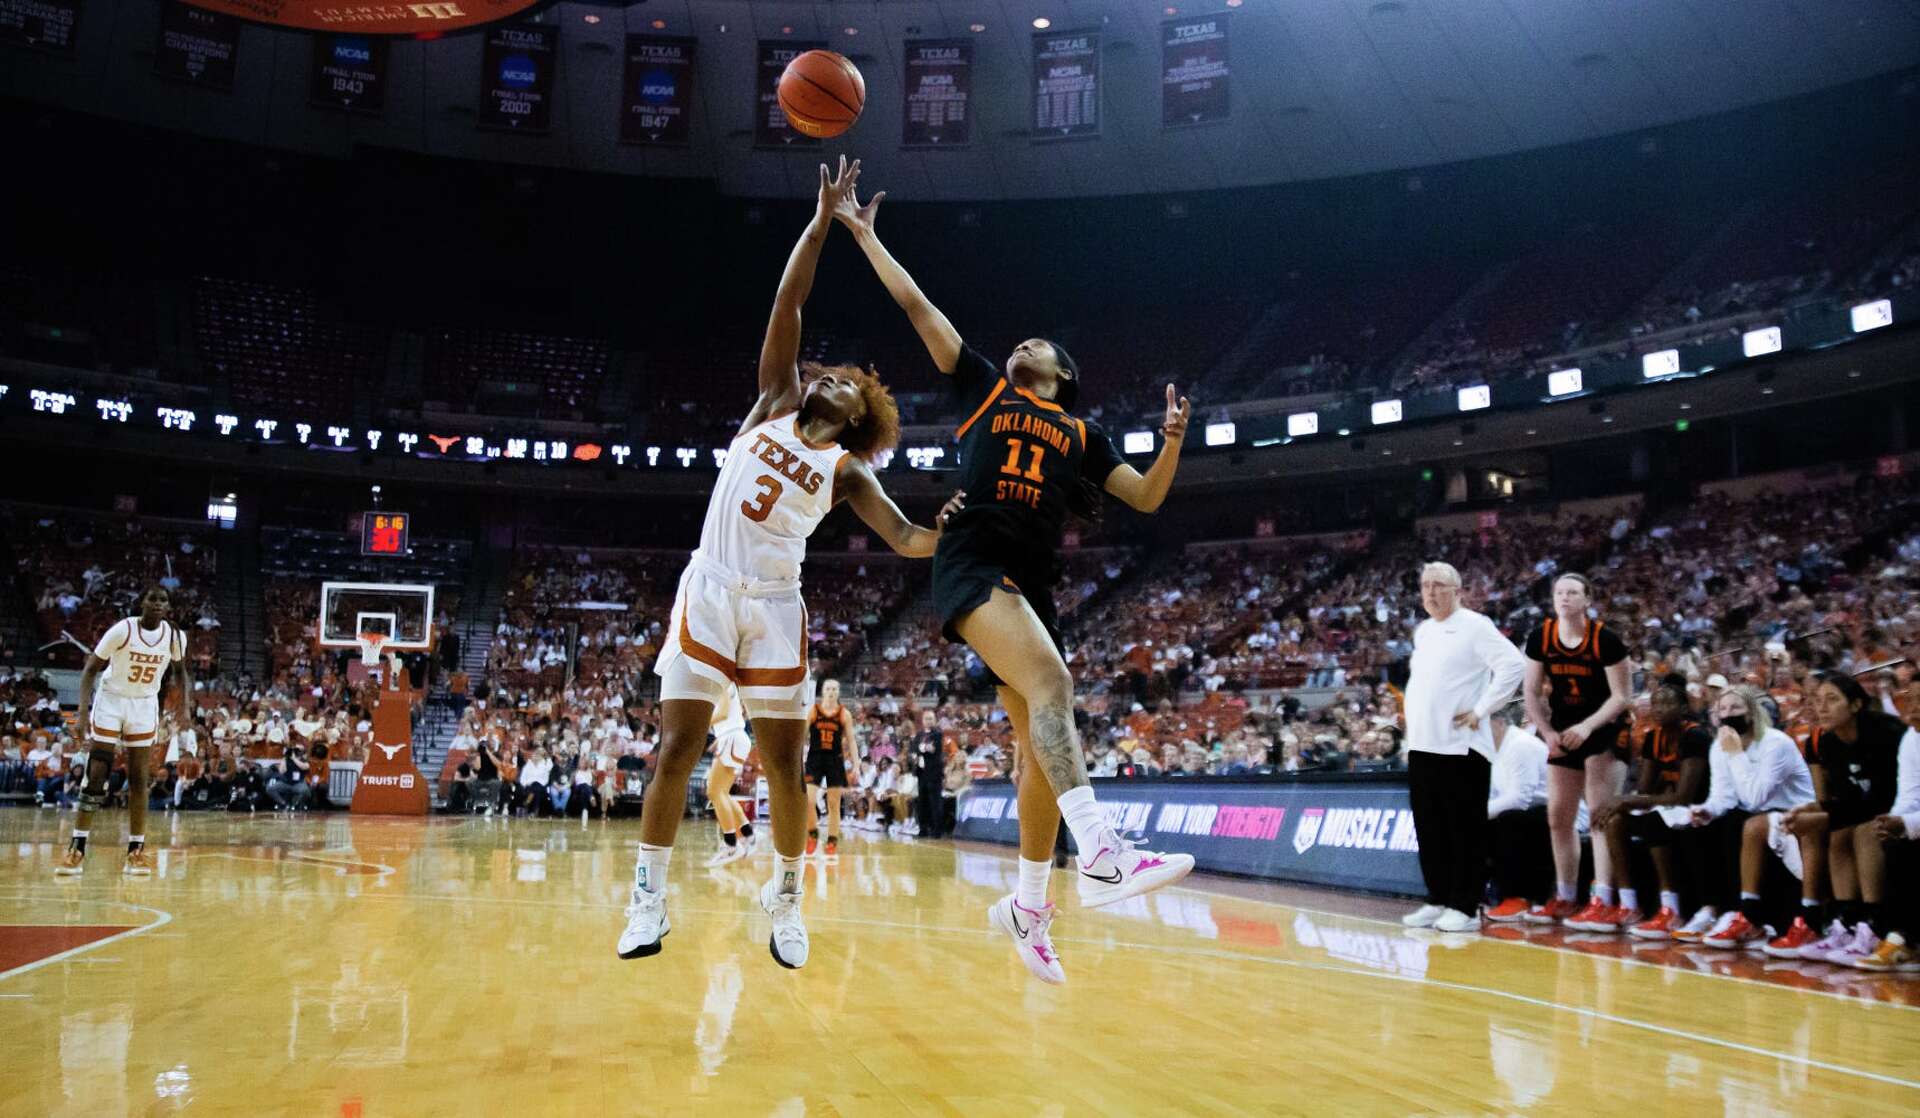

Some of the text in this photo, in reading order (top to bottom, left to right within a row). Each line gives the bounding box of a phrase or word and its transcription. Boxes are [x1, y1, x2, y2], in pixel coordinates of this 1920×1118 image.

[500, 29, 543, 44] TEXAS
[1175, 21, 1217, 38] TEXAS
[640, 45, 681, 57] TEXAS
[1046, 37, 1088, 51] TEXAS
[334, 46, 370, 61] NCAA
[773, 49, 802, 60] TEX
[919, 48, 960, 59] TEXAS
[502, 70, 537, 83] NCAA
[333, 77, 364, 94] 1943
[642, 85, 674, 96] NCAA
[499, 100, 532, 114] 2003
[641, 114, 670, 128] 1947
[992, 414, 1071, 457] OKLAHOMA
[551, 442, 566, 458] 10
[748, 432, 825, 496] TEXAS
[1000, 438, 1046, 484] 11
[740, 474, 784, 523] 3
[996, 479, 1042, 509] STATE
[375, 515, 404, 530] 6:16
[128, 650, 163, 665] TEXAS
[127, 665, 156, 684] 35
[362, 775, 399, 786] TRUIST
[1156, 803, 1187, 833] OWN
[1183, 804, 1219, 835] YOUR
[1211, 804, 1286, 841] STRENGTH
[1318, 807, 1396, 850] MUSCLE
